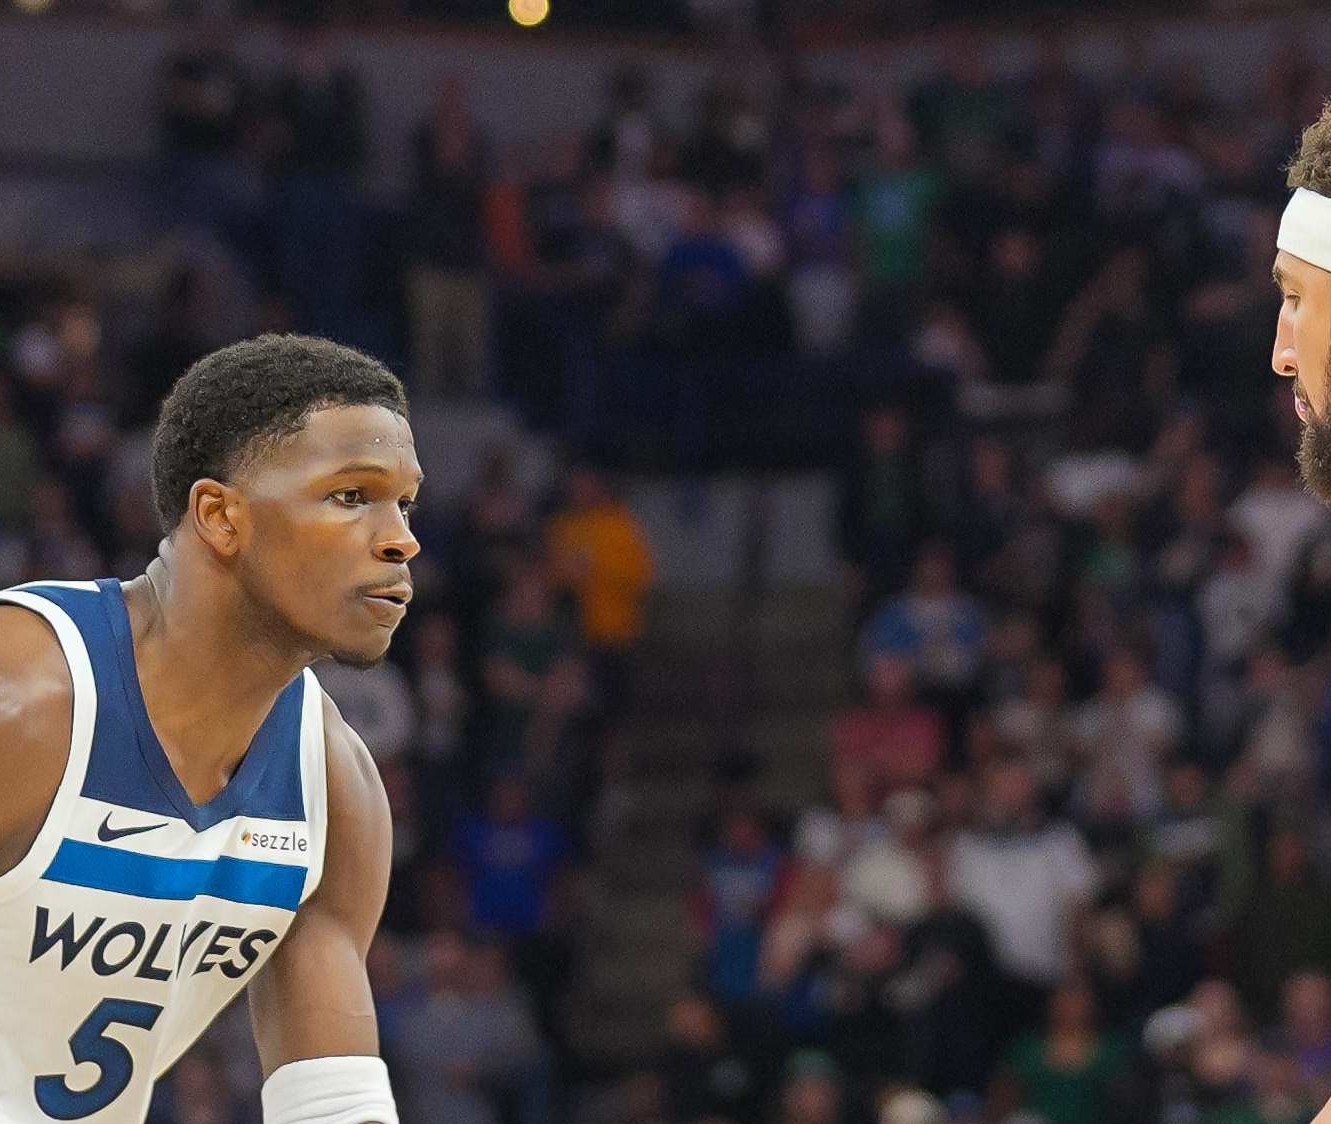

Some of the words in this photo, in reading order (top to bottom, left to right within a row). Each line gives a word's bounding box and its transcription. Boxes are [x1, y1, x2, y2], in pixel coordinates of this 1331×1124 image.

[251, 831, 308, 852] sezzle
[29, 905, 277, 982] WOLVES
[34, 997, 164, 1121] 5
